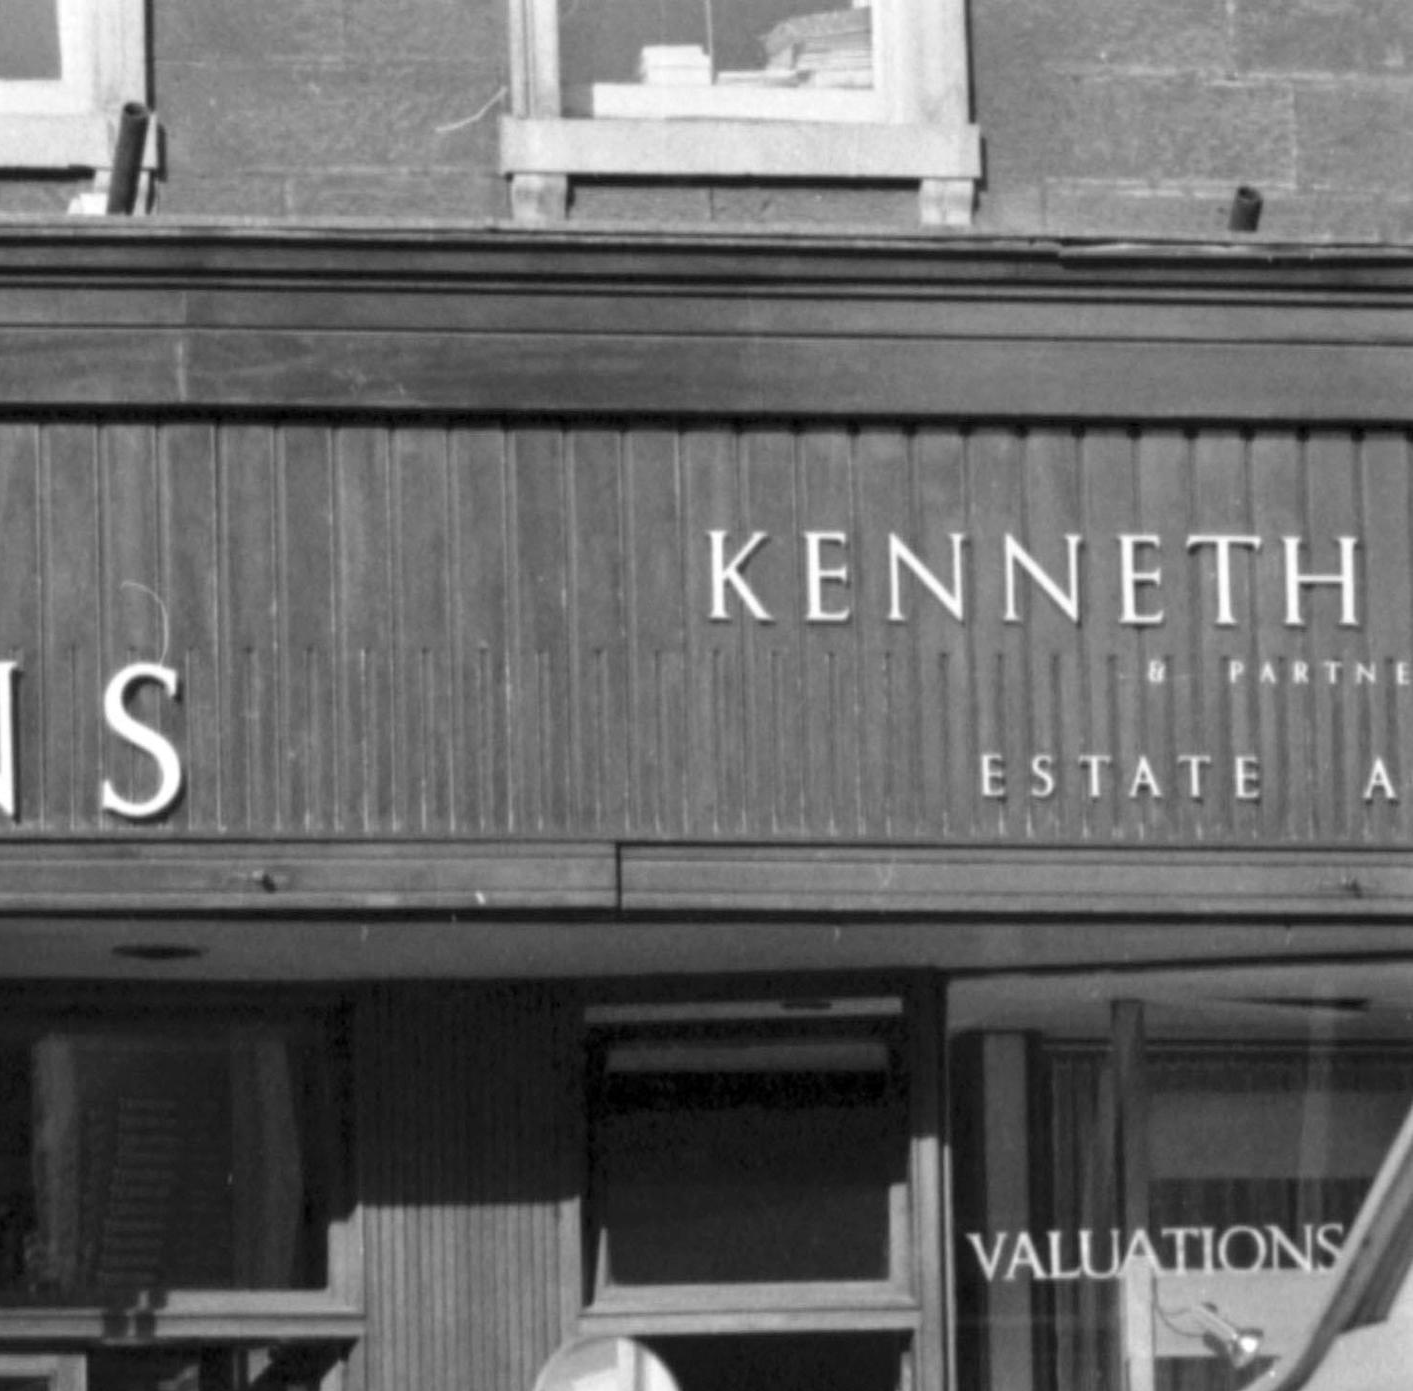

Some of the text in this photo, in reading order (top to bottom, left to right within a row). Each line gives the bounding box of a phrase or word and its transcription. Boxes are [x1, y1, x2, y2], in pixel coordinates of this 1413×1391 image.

[707, 529, 1360, 627] KENNETH
[1147, 659, 1413, 686] & PARTNE
[979, 754, 1397, 801] ESTATE A
[965, 1222, 1347, 1282] VALUATIONS
